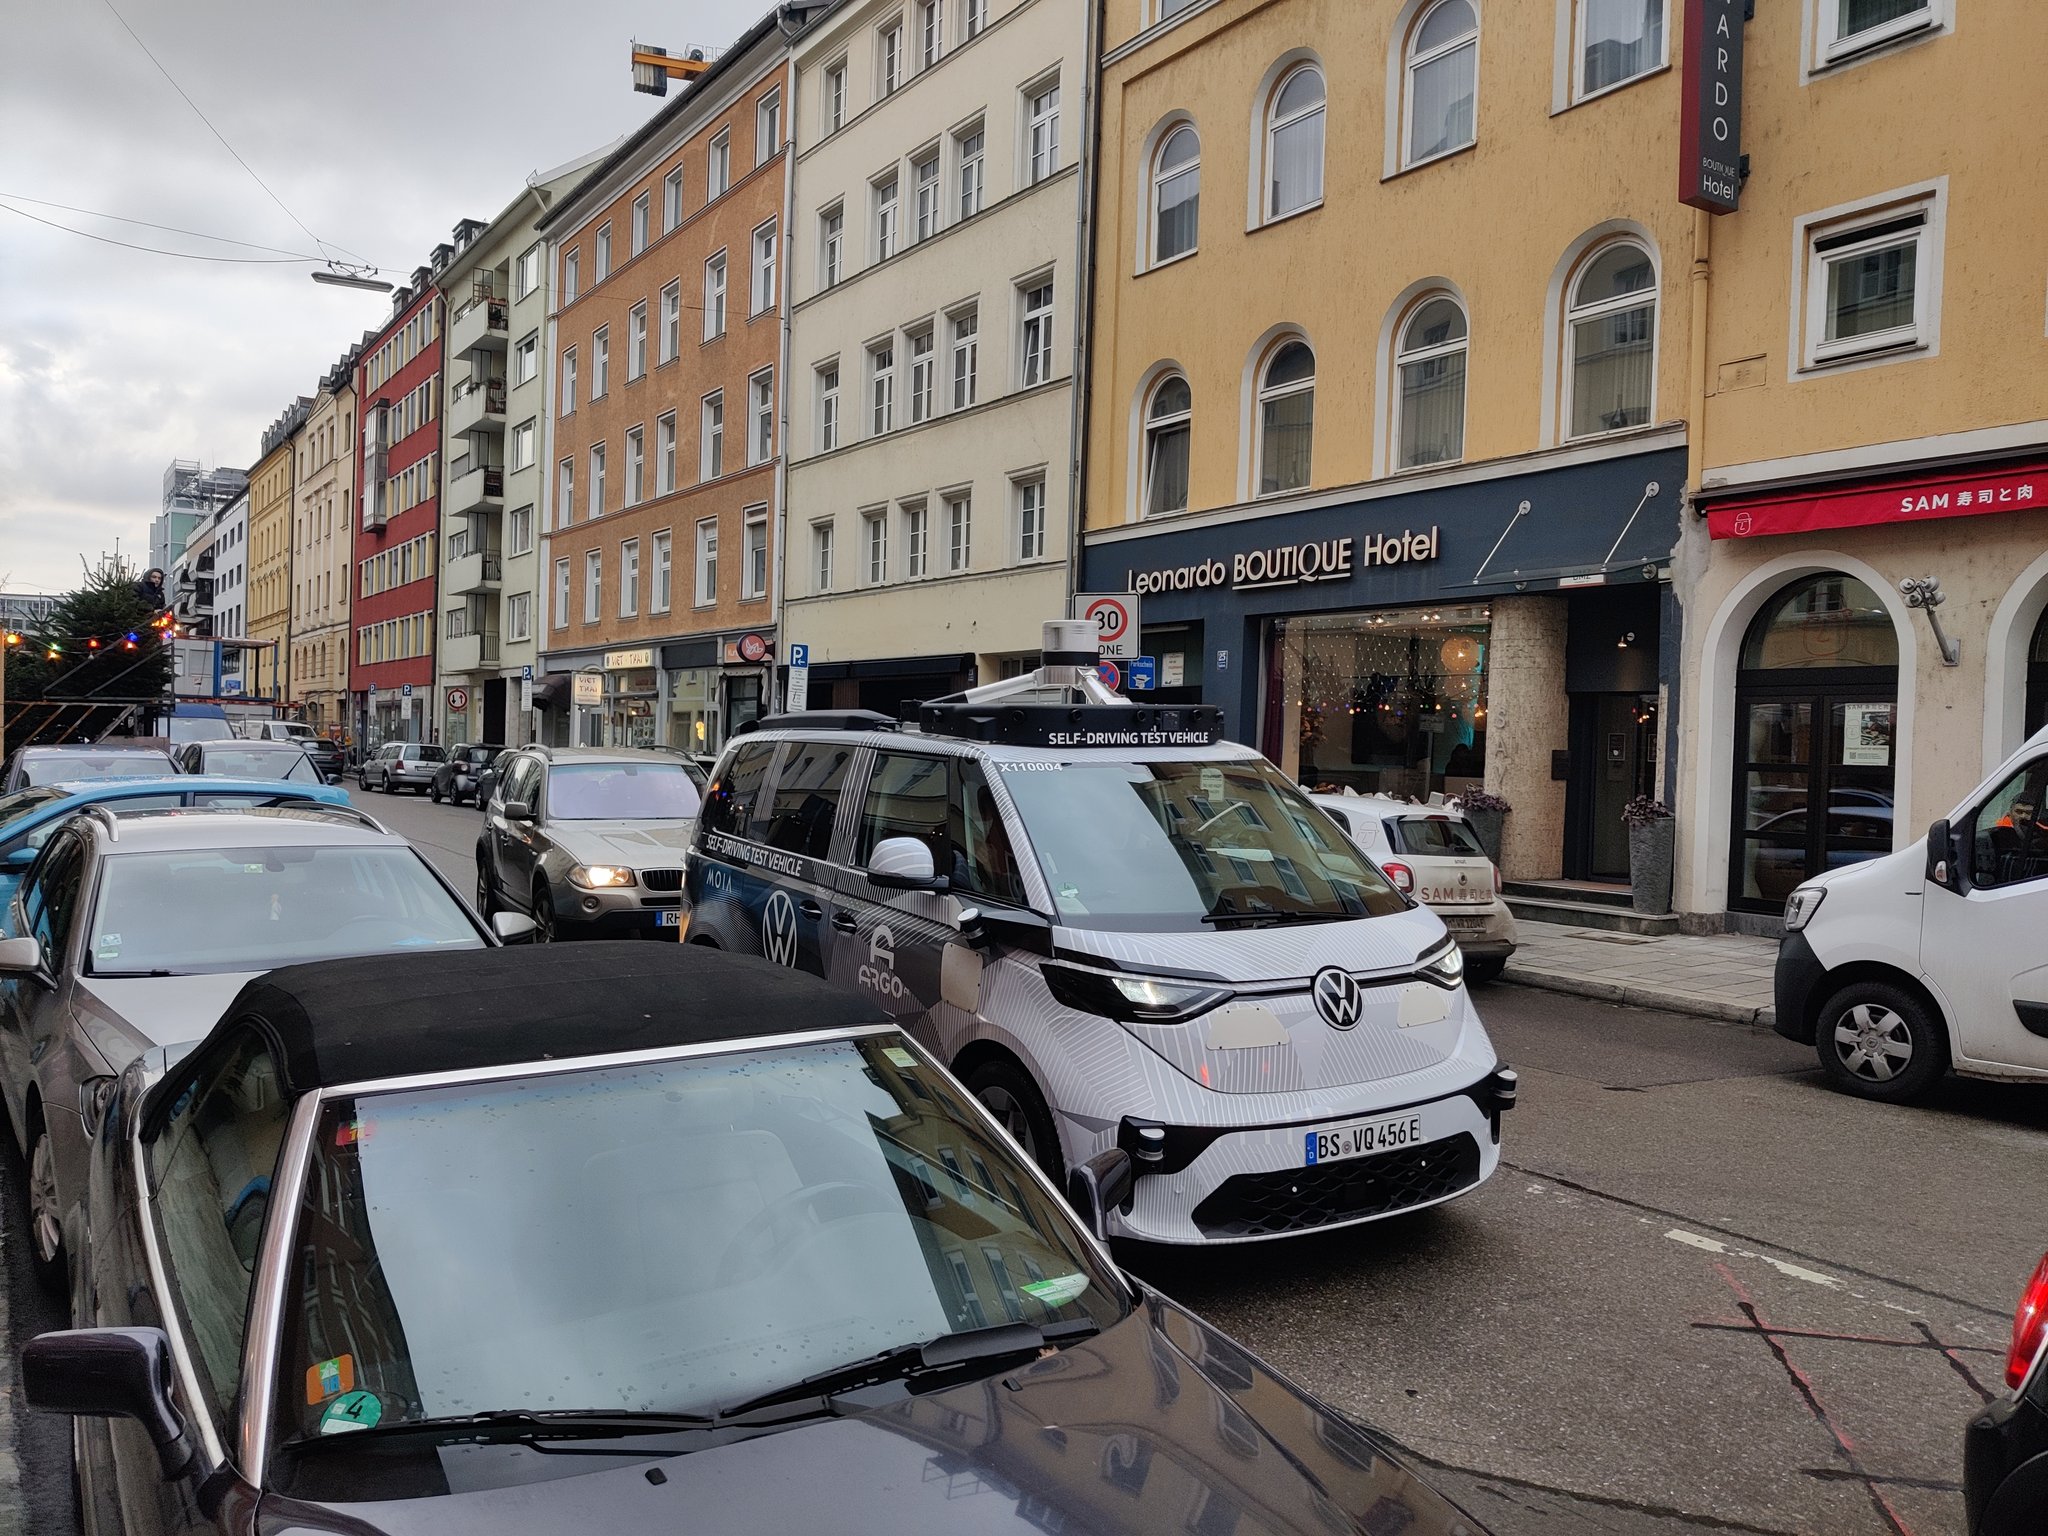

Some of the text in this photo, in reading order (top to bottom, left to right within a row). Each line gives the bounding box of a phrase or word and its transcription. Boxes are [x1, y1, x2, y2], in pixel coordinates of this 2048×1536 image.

[1713, 0, 1730, 141] ARDO
[1703, 157, 1735, 177] BOUTIQUE
[1703, 174, 1734, 200] Hotel
[1900, 484, 2033, 513] SAM 寿司と肉
[1127, 525, 1438, 595] Leonardo BOUTIQUE Hotel
[1094, 610, 1119, 631] 30
[1098, 644, 1123, 656] ONE
[1048, 731, 1209, 745] SELF-DRIVING TEST VEHICLE
[998, 762, 1064, 772] X110004
[706, 834, 803, 877] SELF-DRIVING TEST VEHICLE
[1421, 887, 1454, 901] SAM
[858, 964, 903, 999] ARGO
[1318, 1133, 1341, 1159] BS
[1353, 1127, 1374, 1152] VQ
[345, 1394, 367, 1419] 4
